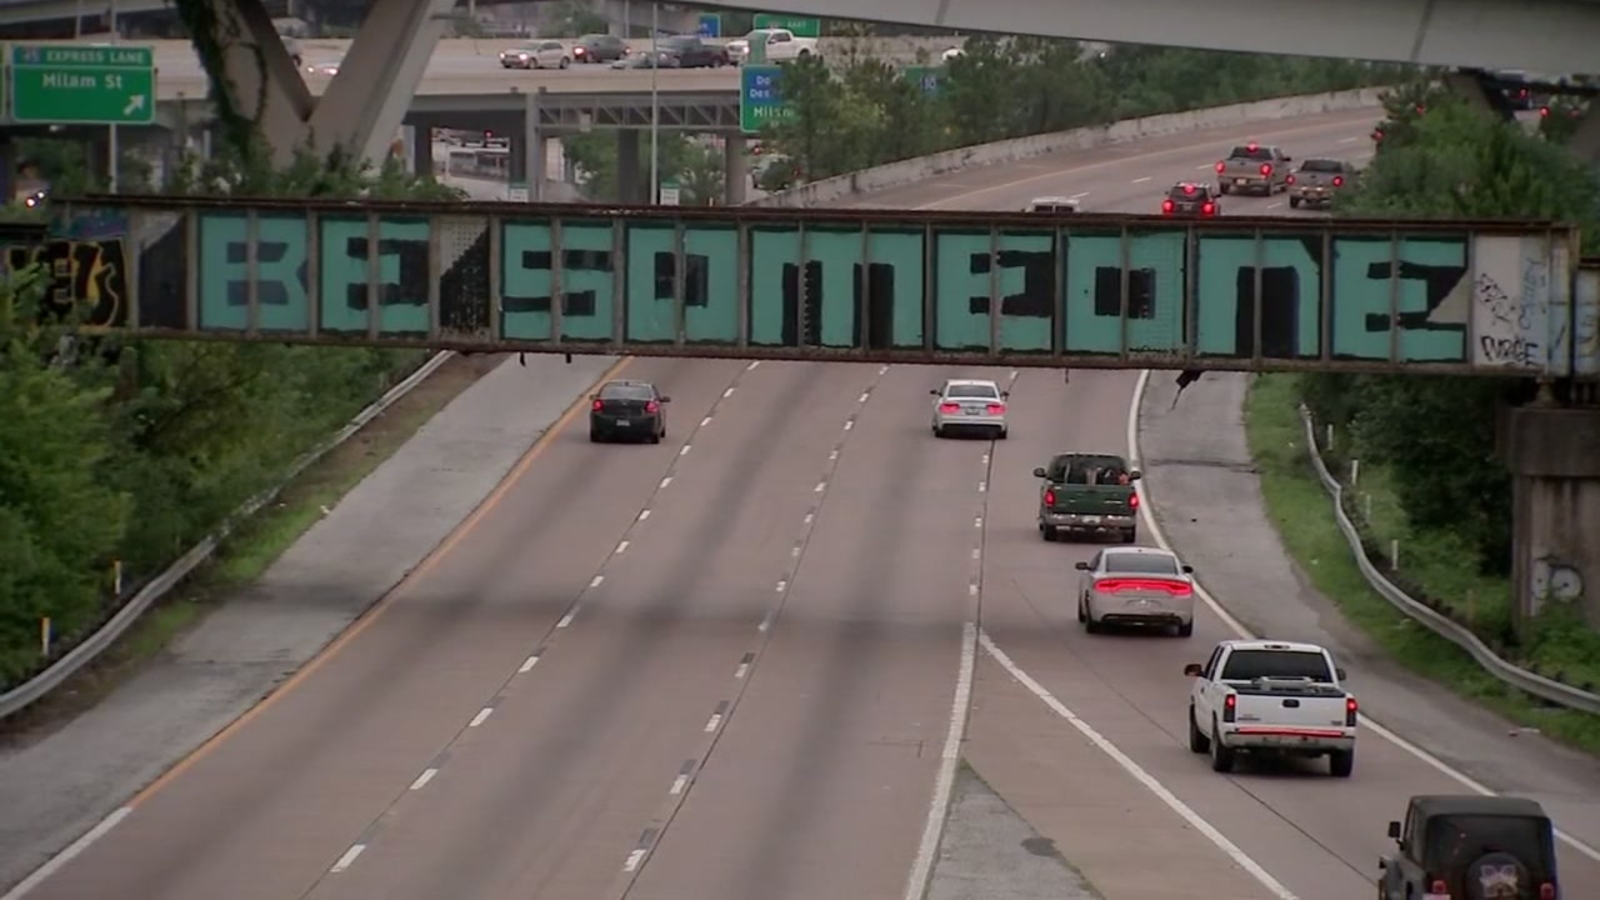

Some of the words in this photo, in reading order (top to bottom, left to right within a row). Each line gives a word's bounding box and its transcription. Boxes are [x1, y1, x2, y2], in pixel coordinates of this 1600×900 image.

[46, 49, 104, 62] EXPRESS
[109, 50, 144, 64] LANE
[42, 73, 96, 88] Milam
[105, 74, 122, 89] St
[201, 214, 430, 333] BE
[502, 222, 1470, 363] SOMEONE
